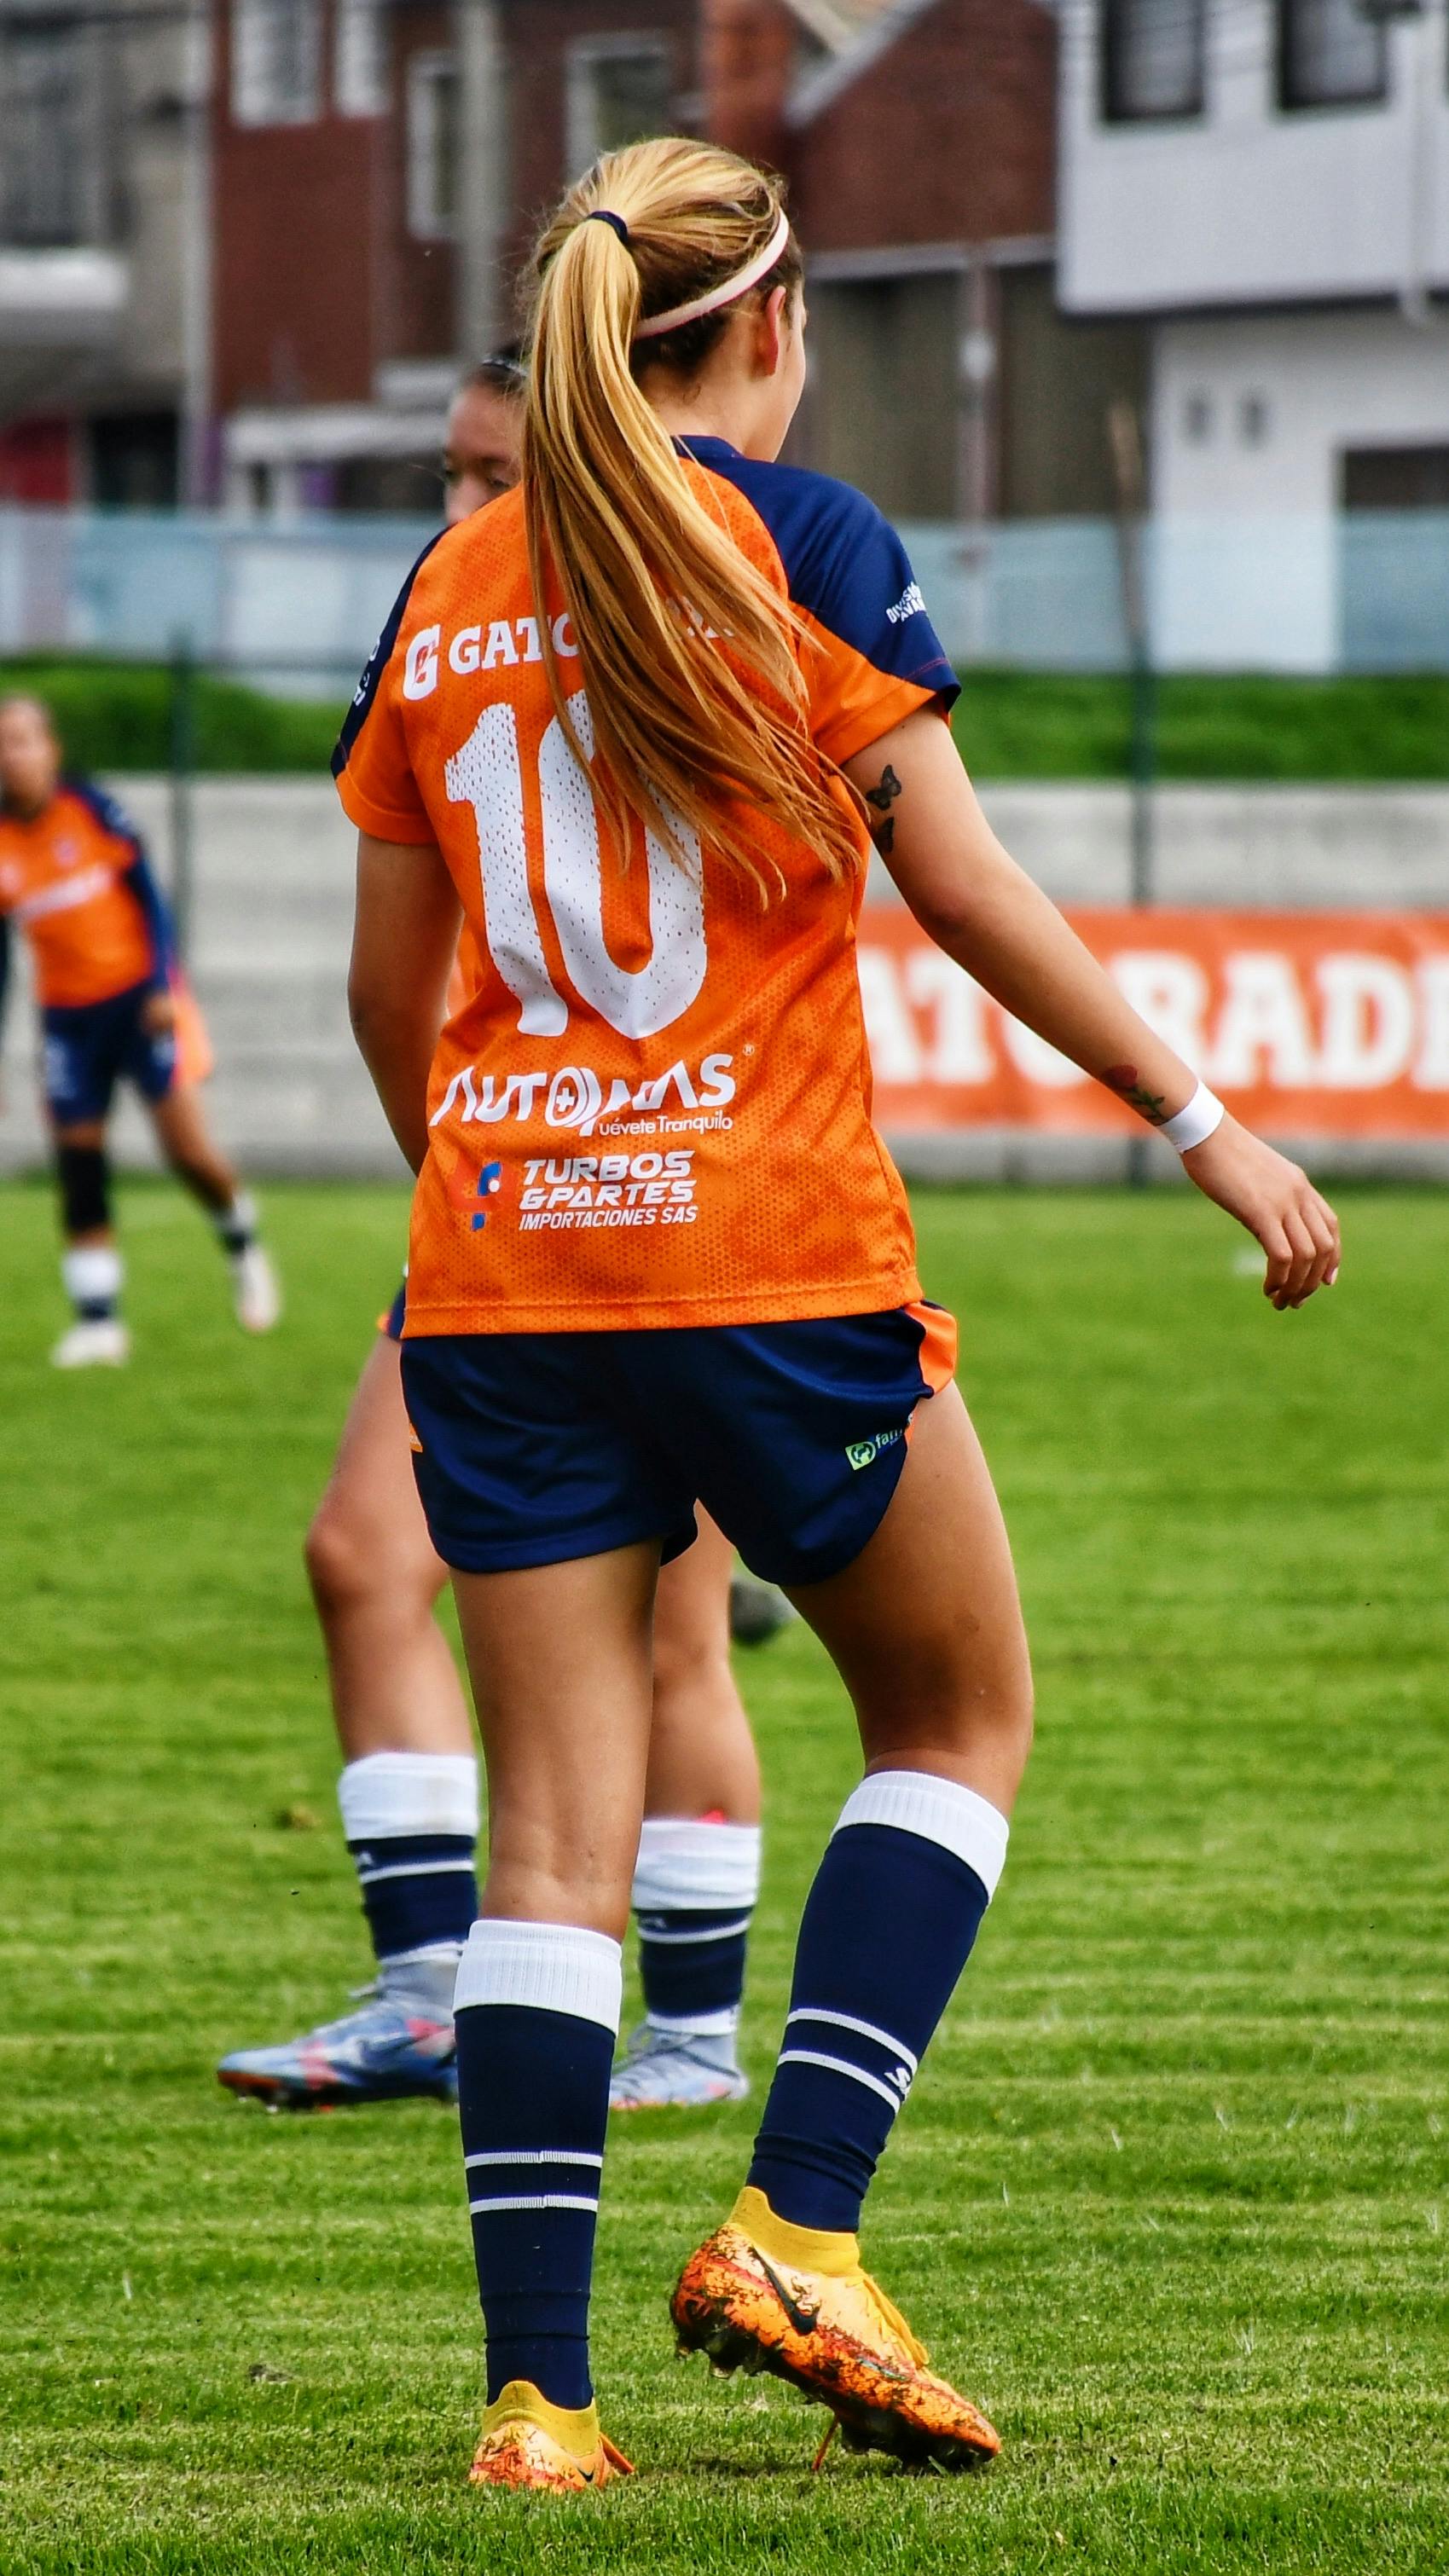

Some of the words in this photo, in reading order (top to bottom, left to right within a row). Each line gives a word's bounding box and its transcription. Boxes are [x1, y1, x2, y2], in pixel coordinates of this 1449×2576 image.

[444, 689, 707, 1039] 10
[657, 1109, 733, 1135] Tranquilo
[523, 1150, 696, 1186] TURBOS
[519, 1207, 658, 1231] IMPORTACIONES
[660, 1206, 698, 1225] SAS
